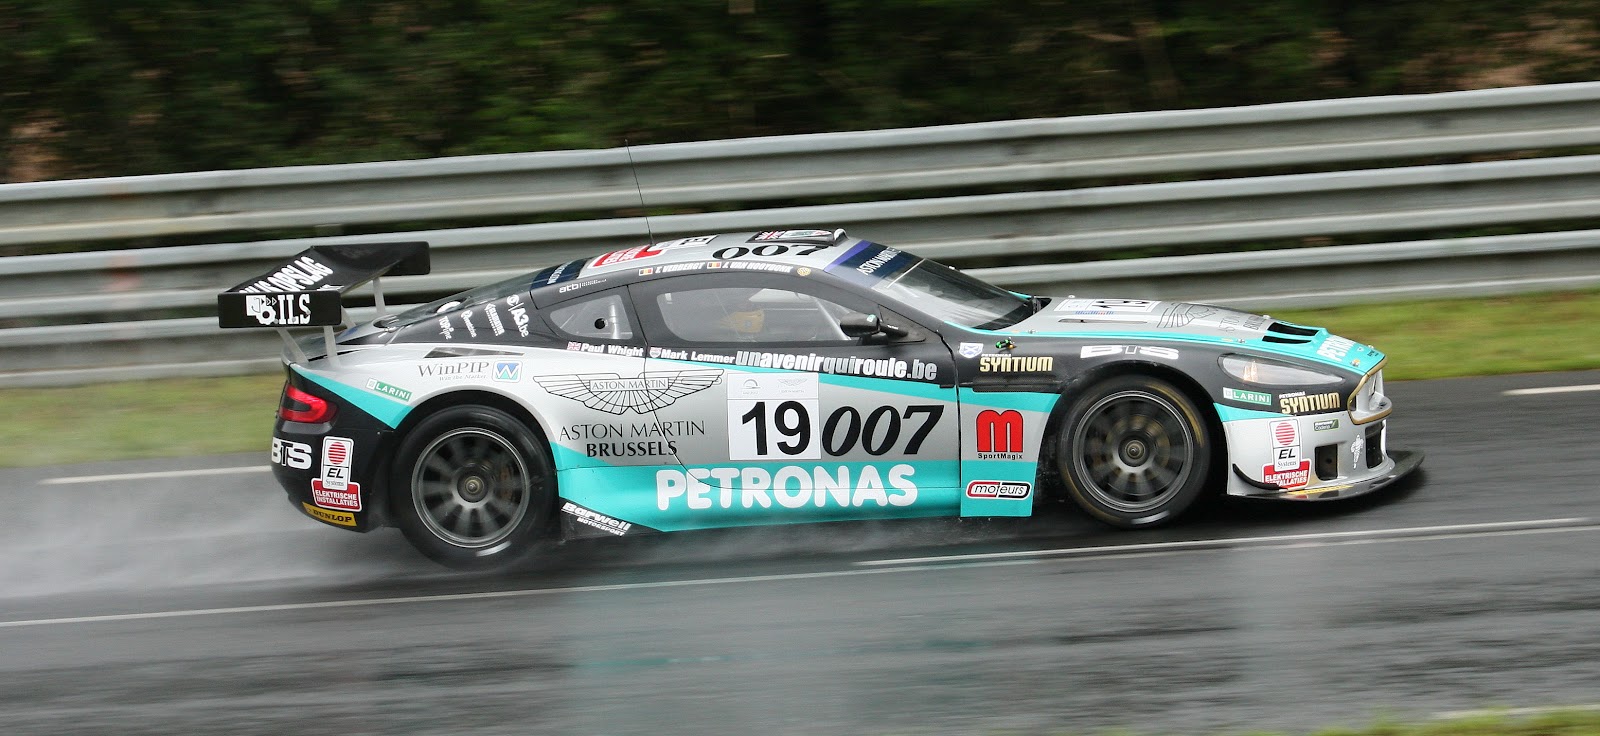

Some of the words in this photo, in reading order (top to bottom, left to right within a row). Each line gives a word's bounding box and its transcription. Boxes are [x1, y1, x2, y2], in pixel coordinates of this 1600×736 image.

[712, 245, 830, 259] 007
[580, 342, 605, 353] Paul
[607, 344, 644, 357] Whight
[660, 349, 688, 361] Mark
[690, 351, 736, 364] Lemmer
[1080, 344, 1179, 360] BTS
[417, 361, 490, 377] WinPIP
[735, 350, 938, 381] unavenirquiroule.be
[979, 356, 1054, 372] SYNTIUM
[375, 381, 412, 400] LARINI
[591, 381, 627, 390] ASTON
[628, 379, 667, 389] MARTIN
[1233, 391, 1270, 403] LARINI
[1279, 392, 1341, 415] SYNTIUM
[559, 423, 624, 442] ASTON
[630, 420, 706, 438] MARTIN
[741, 400, 811, 456] 19
[822, 405, 945, 457] 007
[271, 436, 313, 470] BTS
[586, 440, 678, 458] BRUSSELS
[978, 452, 1023, 460] SportMagix
[1278, 448, 1297, 459] EL
[327, 467, 345, 479] EL
[1264, 469, 1308, 482] ELEKTRISCHE
[655, 464, 919, 511] PETRONAS
[1266, 476, 1308, 487] TALLATIES
[315, 489, 358, 500] ELEKTRISCHE
[316, 496, 359, 507] INSTALLATIES
[561, 502, 632, 531] Barwell
[576, 515, 626, 537] MOTORSPORT
